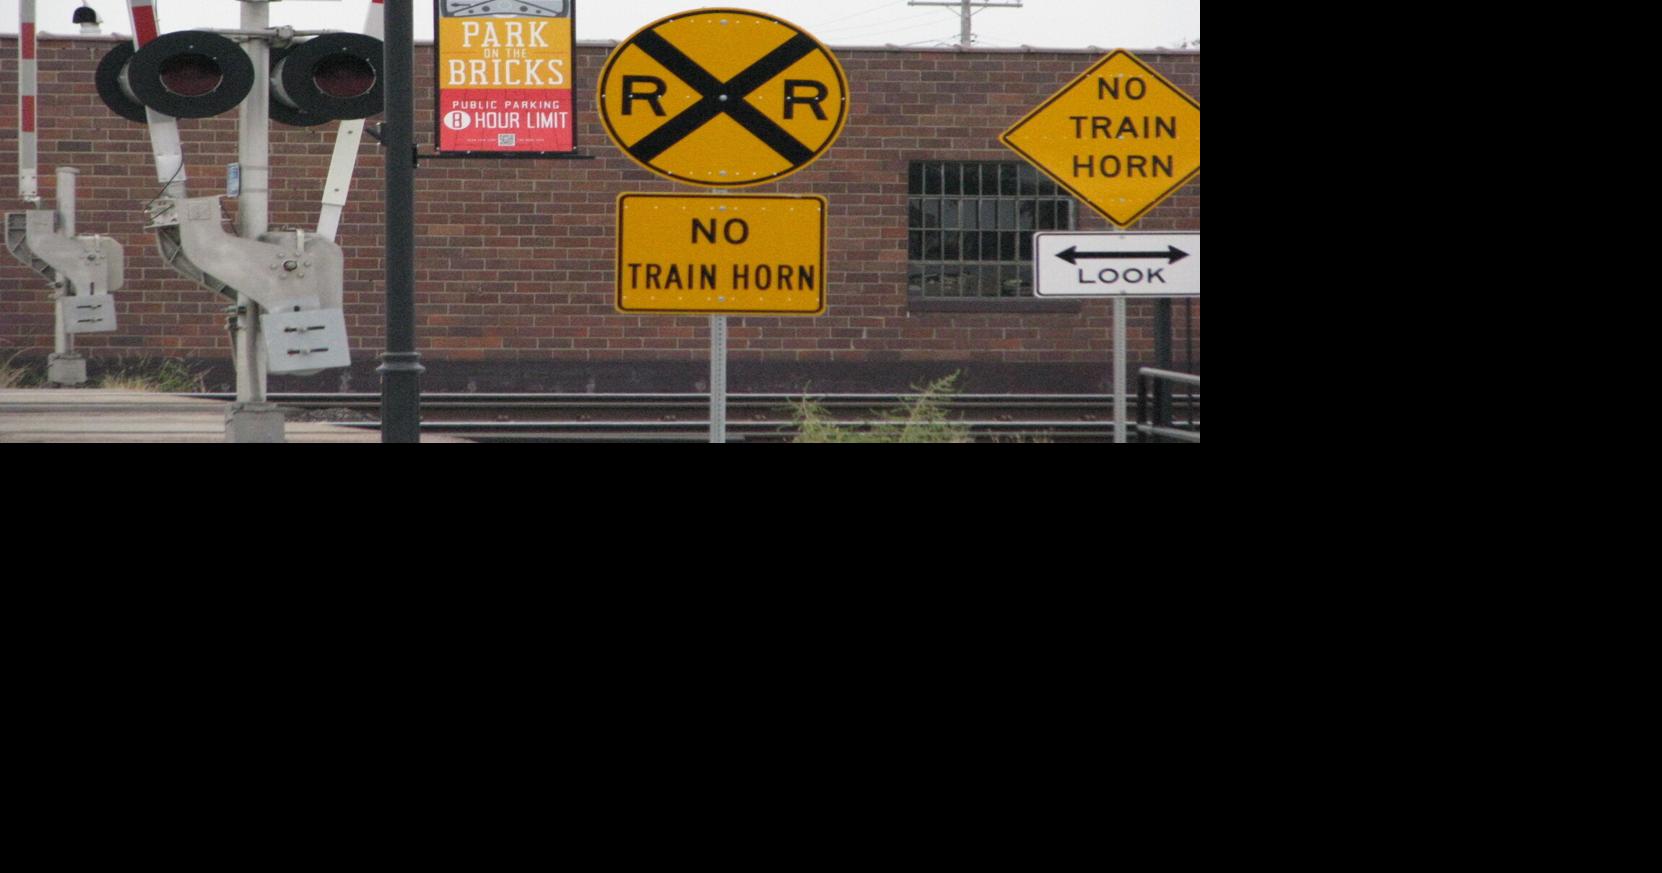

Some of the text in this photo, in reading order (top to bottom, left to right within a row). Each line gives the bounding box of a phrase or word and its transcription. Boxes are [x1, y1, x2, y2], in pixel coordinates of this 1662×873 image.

[462, 21, 549, 47] PARK
[484, 49, 527, 58] ON THE
[448, 59, 563, 85] BRICKS
[621, 75, 828, 121] R R
[1098, 77, 1146, 100] NO
[452, 101, 560, 109] PUBLIC PARKING
[452, 112, 568, 128] 8 HOUR LIMIT
[1069, 116, 1176, 139] TRAIN
[1073, 155, 1173, 177] HORN
[691, 218, 749, 244] NO
[628, 263, 814, 291] TRAIN HORN
[1078, 268, 1166, 283] LOOK
